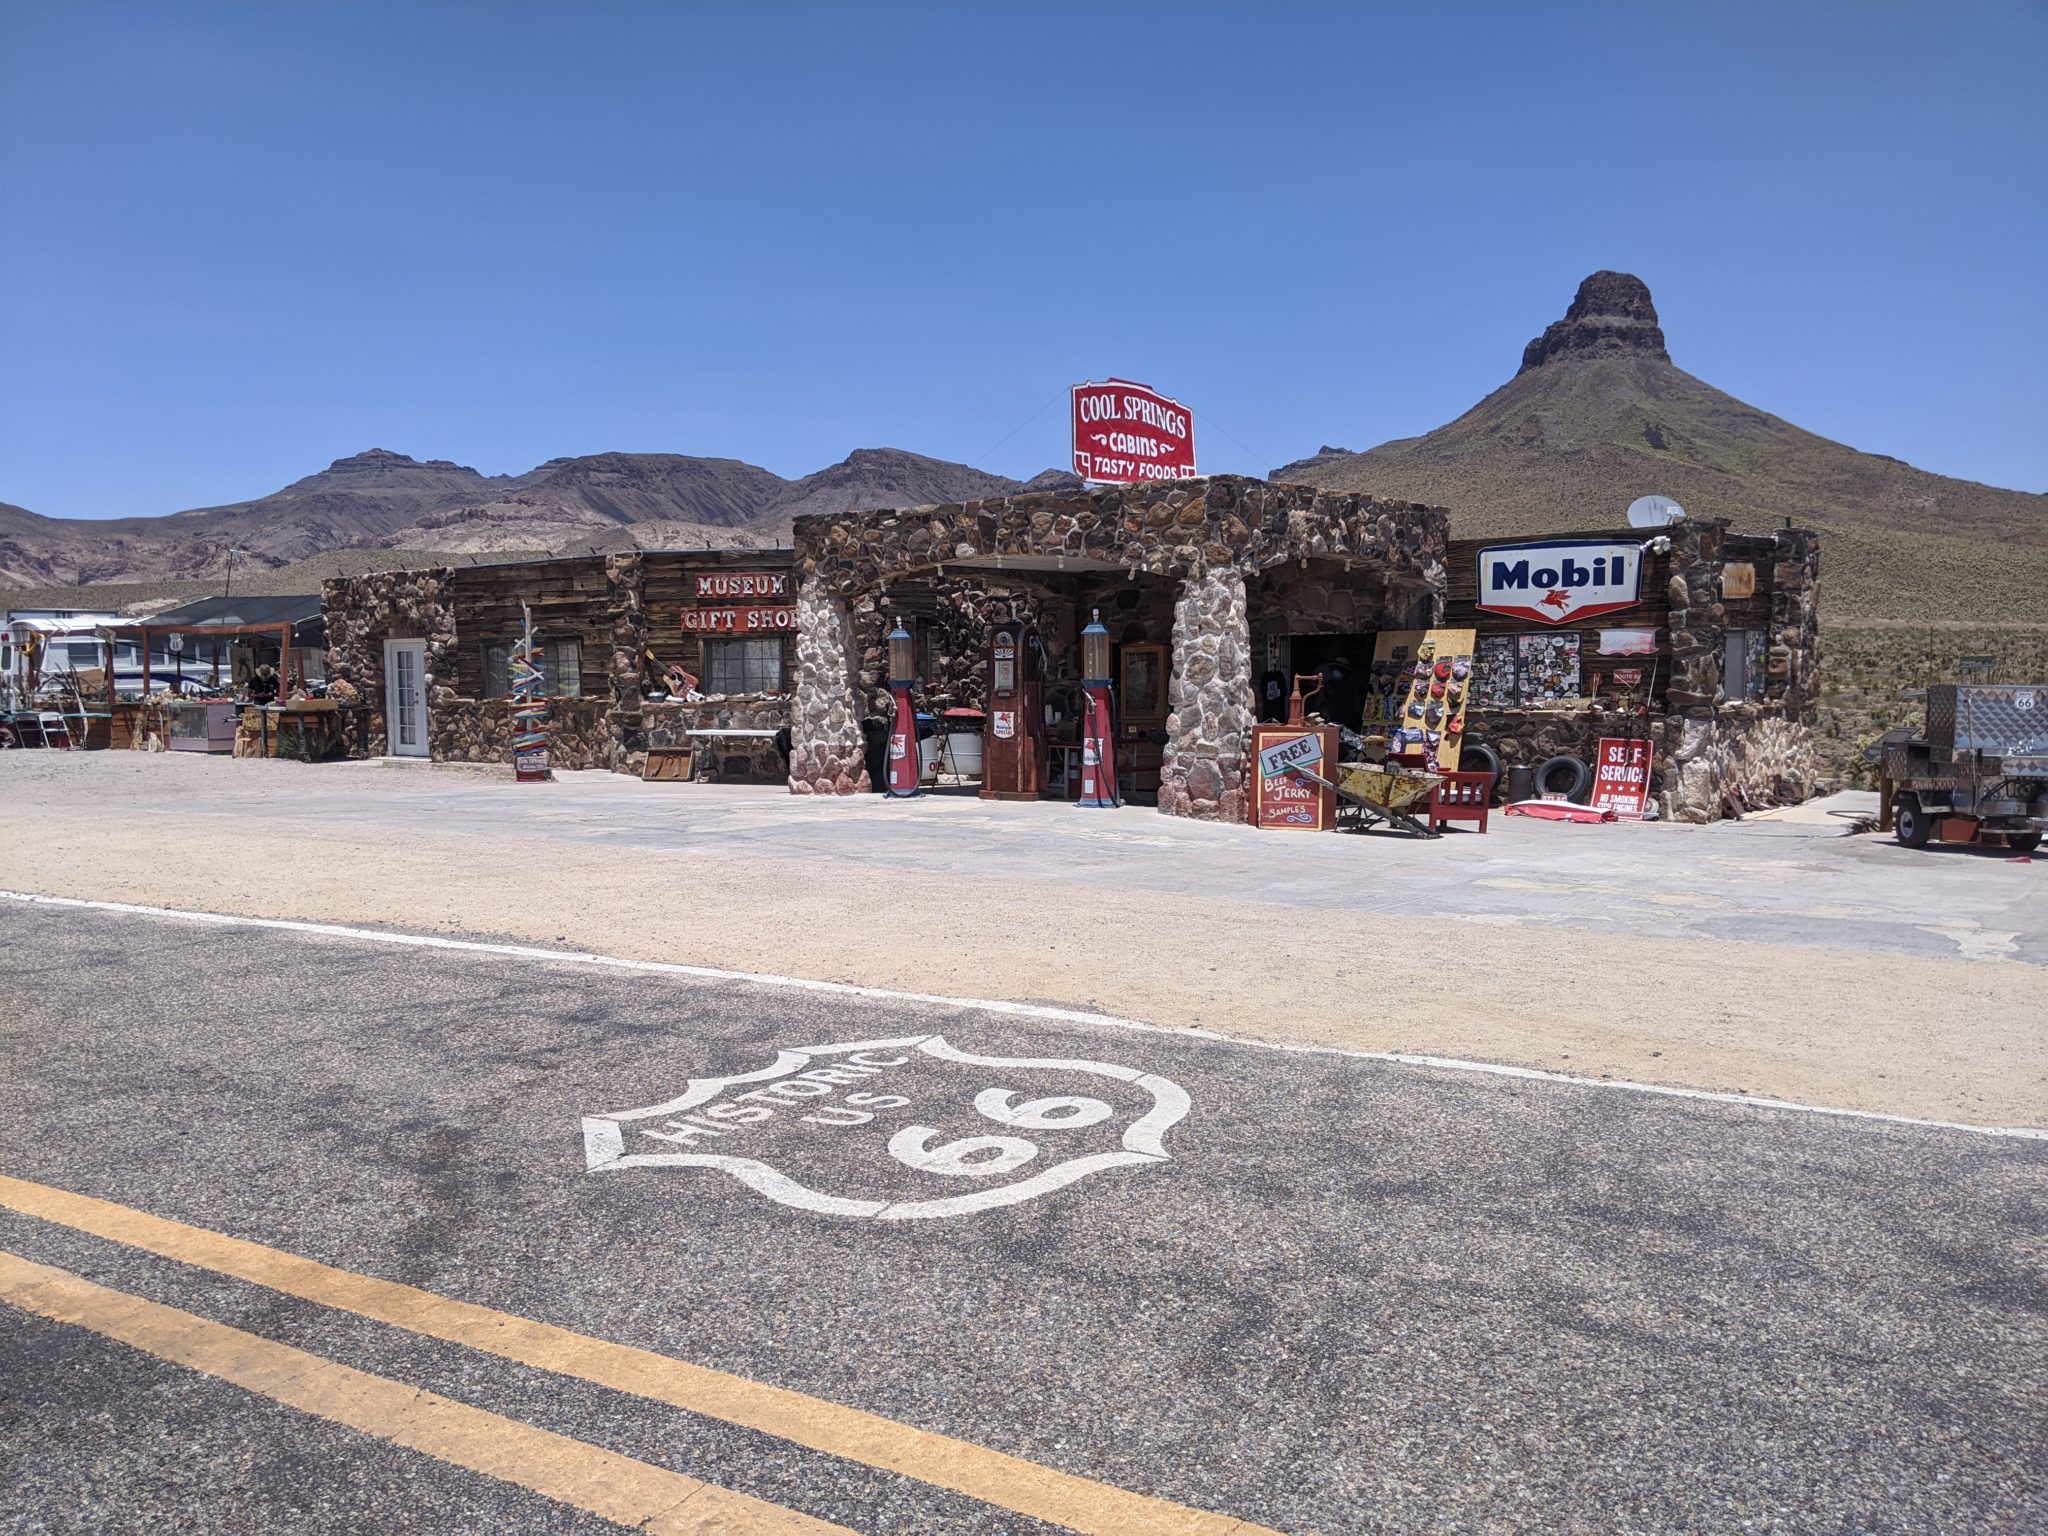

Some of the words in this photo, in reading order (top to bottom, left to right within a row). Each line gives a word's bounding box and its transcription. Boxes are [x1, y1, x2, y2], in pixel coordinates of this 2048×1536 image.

[1081, 394, 1121, 422] COOL
[1123, 396, 1186, 438] SPRINGS
[1109, 432, 1158, 457] CABINS
[1094, 457, 1135, 476] TASTY
[1138, 462, 1177, 480] FOODS
[1492, 556, 1625, 590] Mobil
[698, 576, 786, 595] MUSEUM
[684, 610, 736, 629] GIFT
[747, 610, 800, 628] SHOP
[2019, 699, 2032, 708] 66
[1268, 739, 1312, 770] FREE
[1264, 777, 1288, 792] BEEF
[1273, 785, 1311, 801] JERKY
[1600, 794, 1609, 802] NO
[1610, 795, 1639, 805] SMOKING
[1612, 804, 1638, 813] ENGINES
[640, 1052, 909, 1146] HISTORIC
[800, 1092, 911, 1126] US
[888, 1088, 1113, 1176] 66
